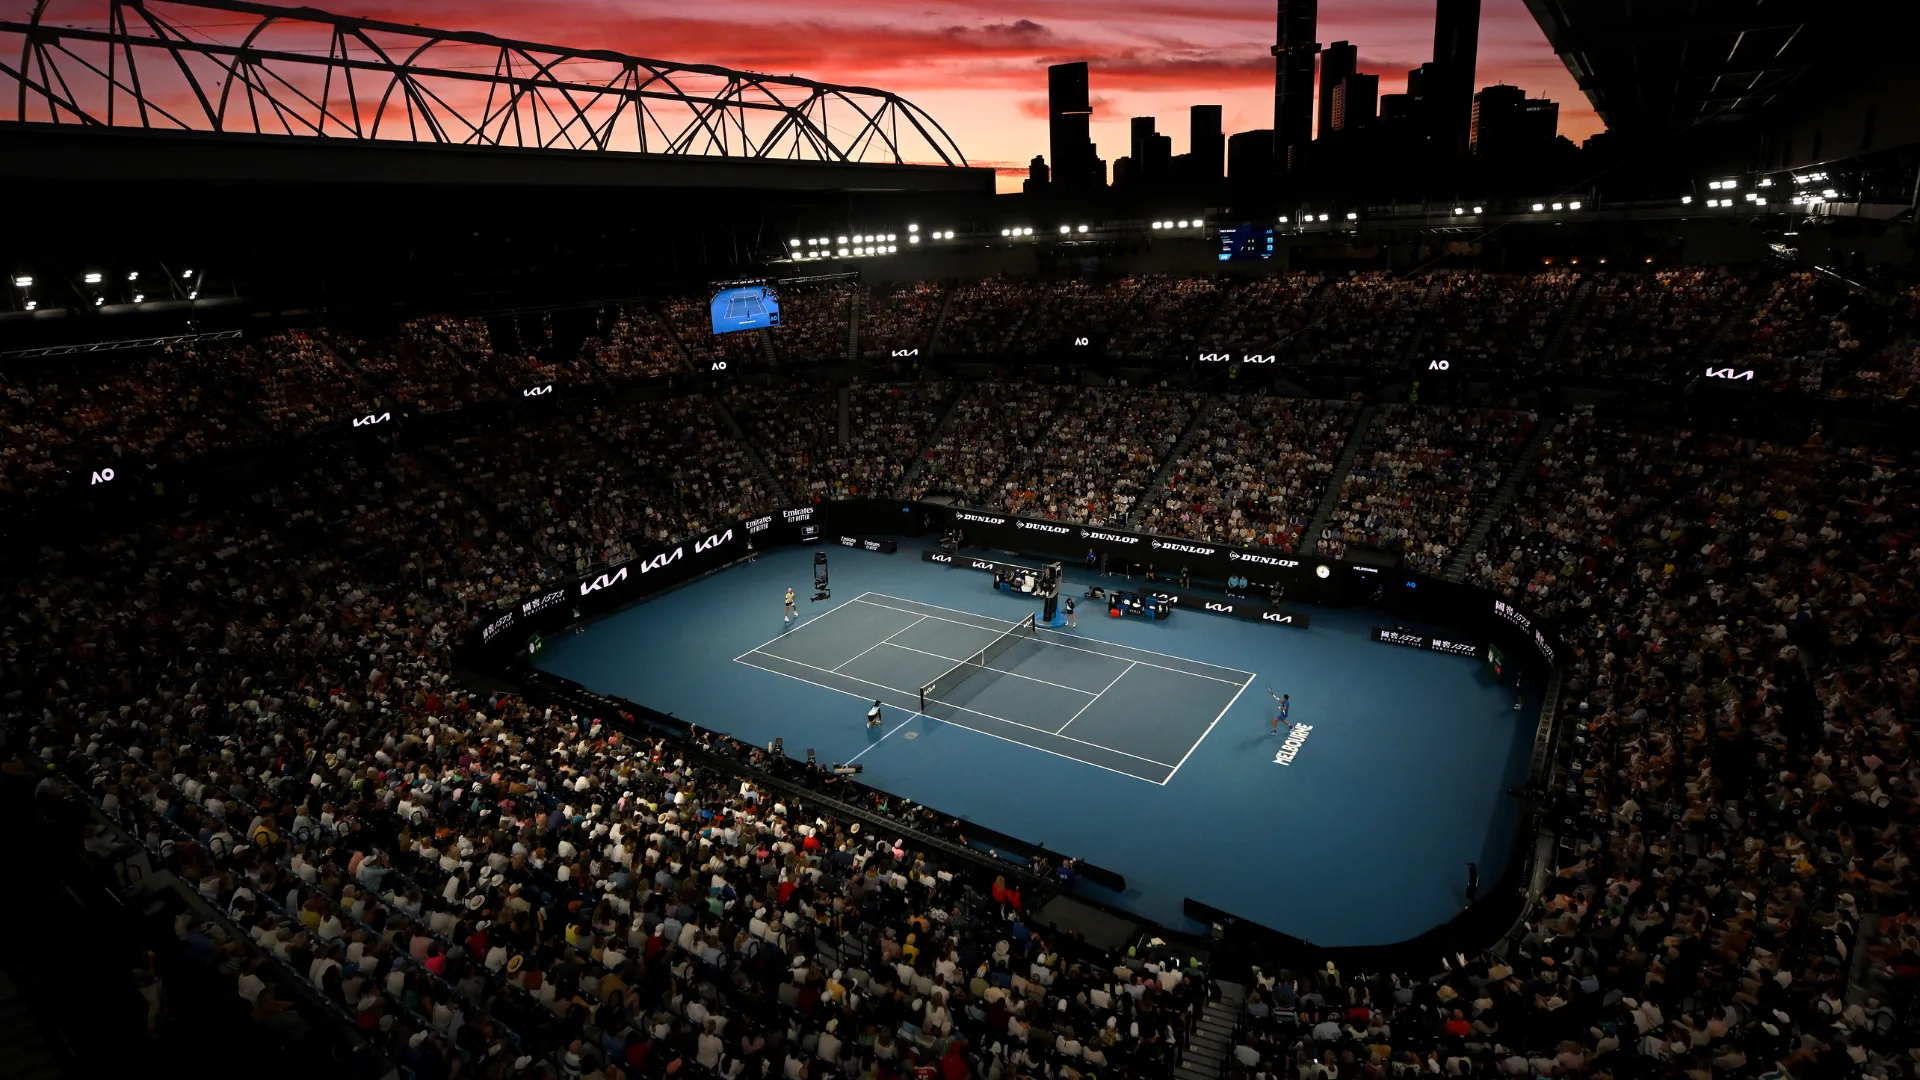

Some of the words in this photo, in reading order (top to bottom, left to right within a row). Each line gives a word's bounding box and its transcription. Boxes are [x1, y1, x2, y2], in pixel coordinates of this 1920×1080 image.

[1075, 337, 1089, 346] AO
[892, 348, 919, 357] KIA
[1199, 353, 1230, 362] KIA
[1243, 354, 1276, 363] KIA
[711, 361, 727, 371] AO
[1429, 359, 1450, 371] AO
[1705, 367, 1754, 381] KIA
[523, 385, 553, 397] KIA
[352, 412, 391, 427] KIA
[91, 467, 115, 485] AO
[783, 507, 814, 518] Emirates
[745, 515, 772, 530] Emirates
[964, 513, 1005, 525] DUNLOP
[1025, 522, 1070, 534] DUNLOP
[694, 528, 733, 554] KIA
[1090, 533, 1139, 544] DUNLOP
[1162, 542, 1215, 555] DUNLOP
[640, 546, 683, 574] KIA
[931, 554, 952, 563] KIA
[1241, 555, 1299, 567] DUNLOP
[972, 560, 996, 570] KIA
[580, 567, 628, 596] KIA
[1406, 581, 1417, 589] AO
[1205, 602, 1233, 613] KIA
[1262, 612, 1292, 623] KIA
[1272, 722, 1314, 766] MELBOURNE
